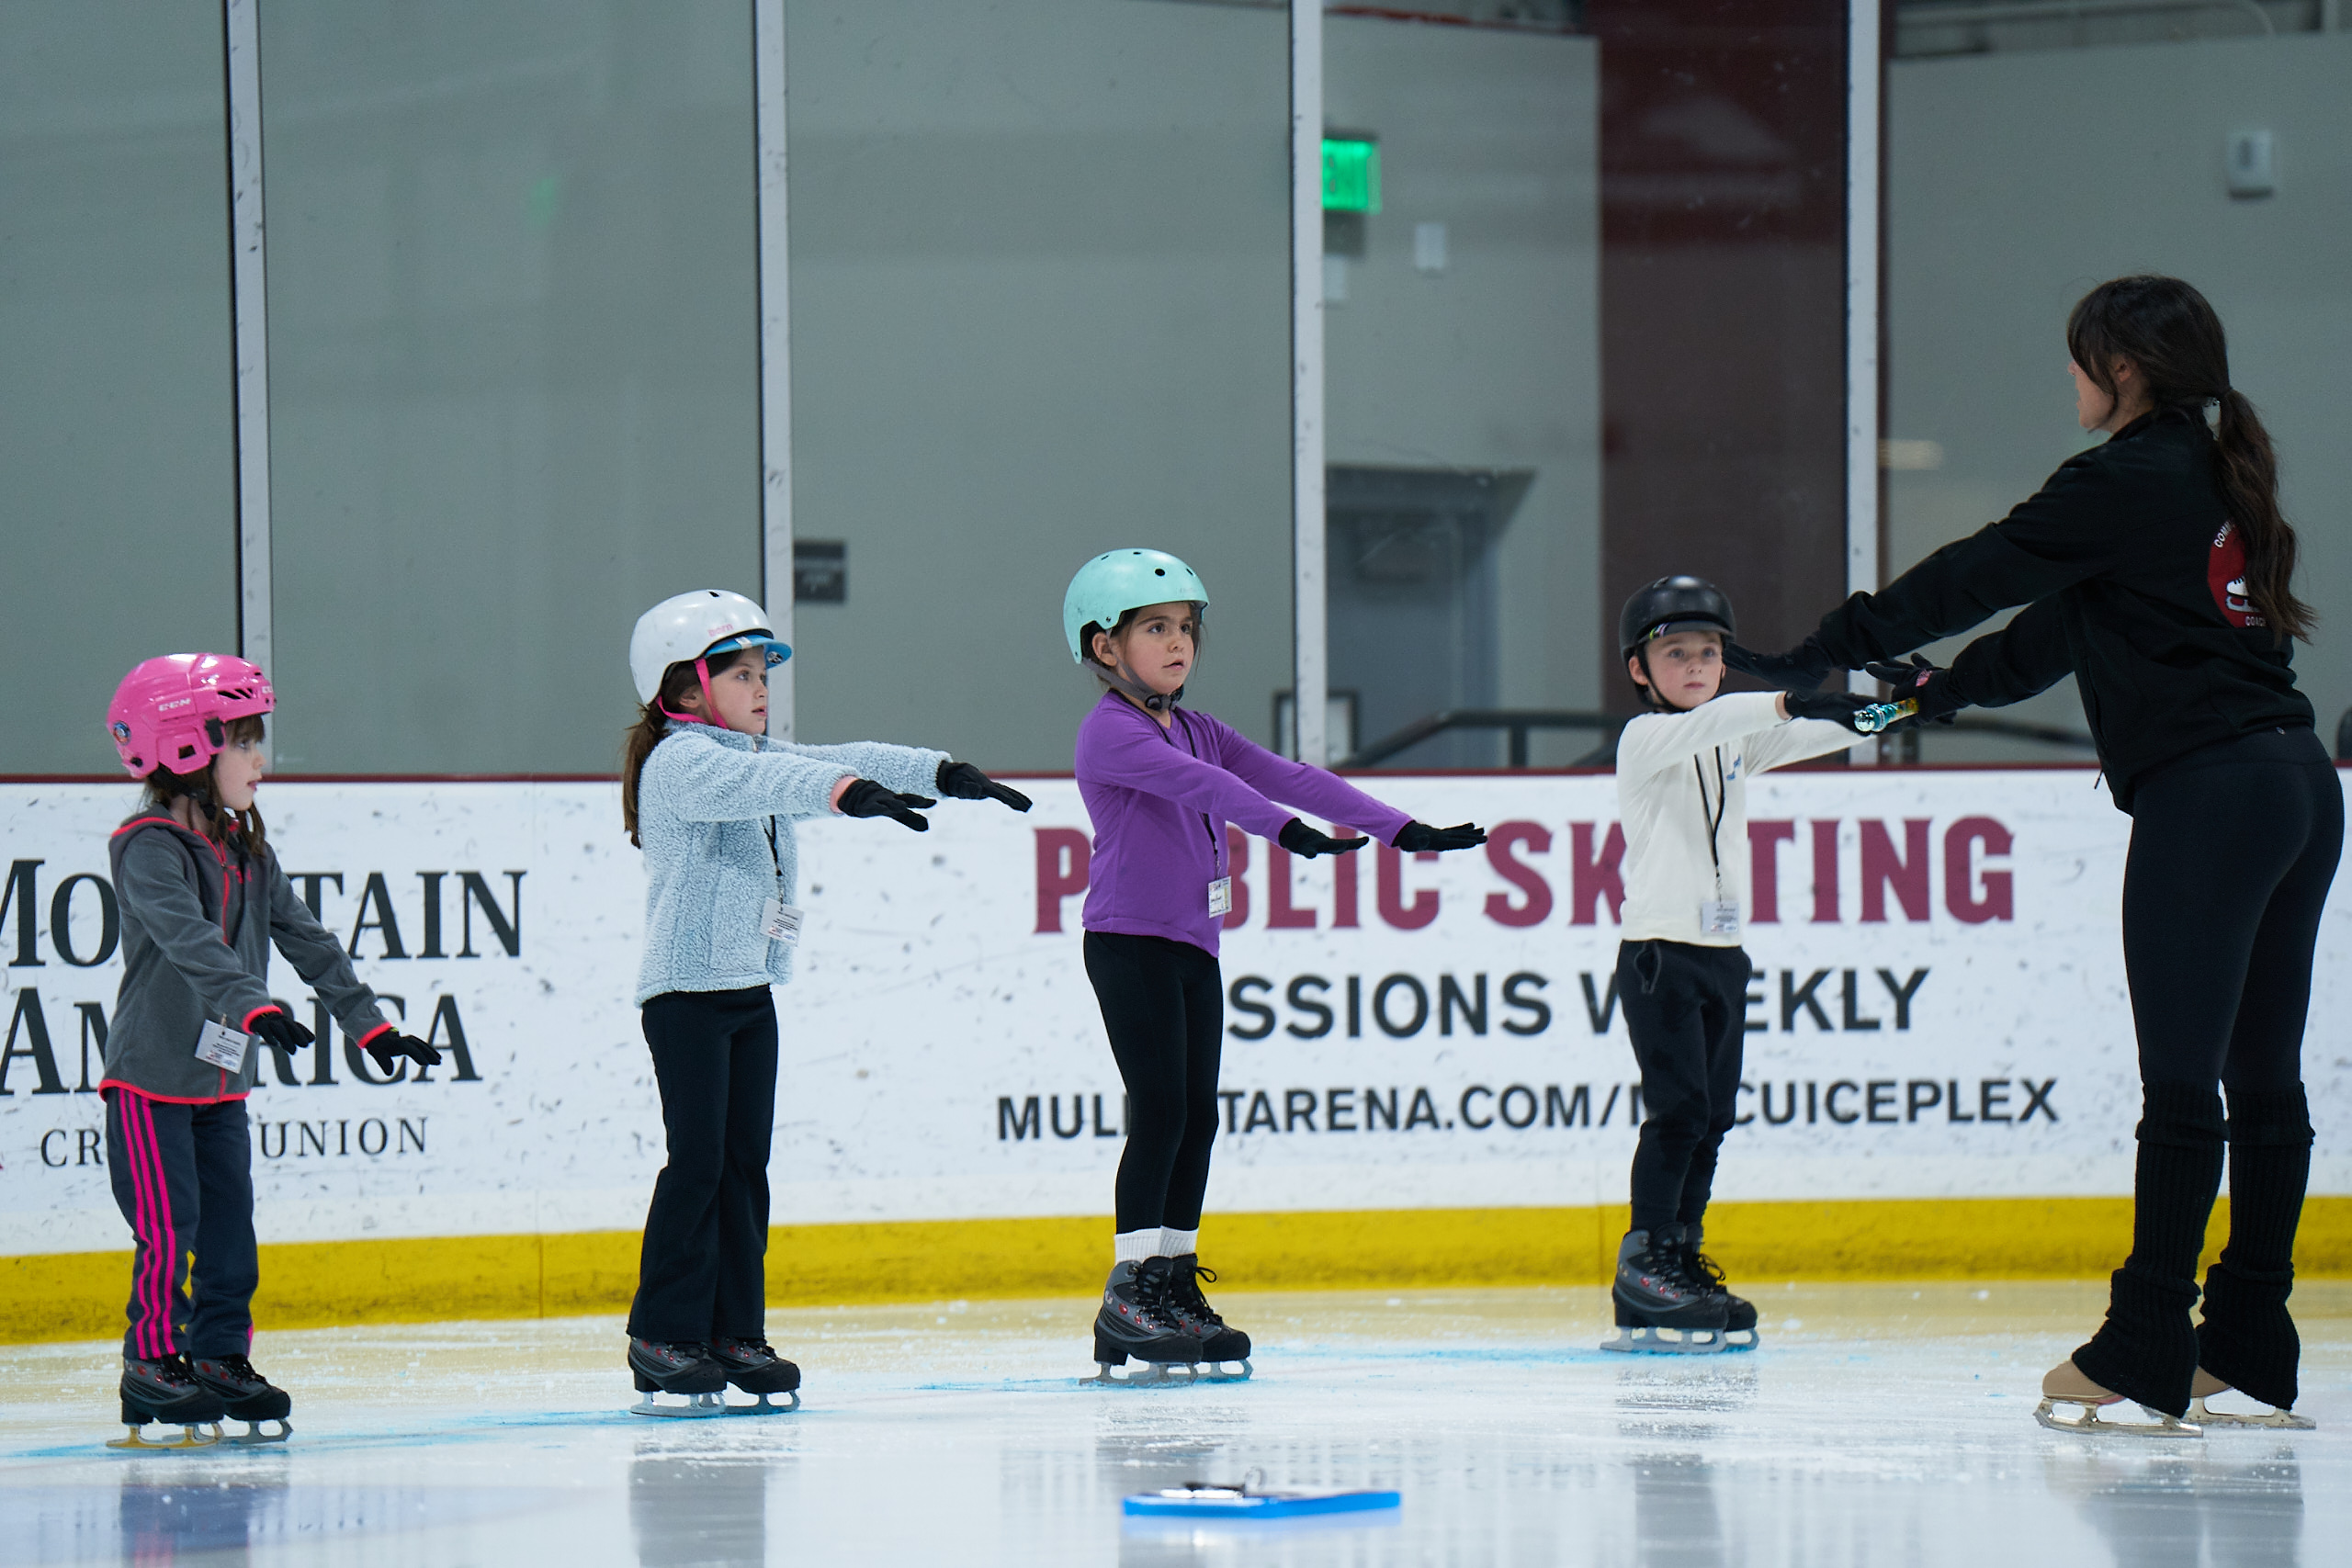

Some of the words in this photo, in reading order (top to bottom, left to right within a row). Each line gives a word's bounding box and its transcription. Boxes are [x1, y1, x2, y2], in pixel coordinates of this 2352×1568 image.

[0, 859, 528, 967] OTAIN
[1034, 824, 1440, 933] PLIC
[1482, 815, 2016, 928] SKTING
[0, 987, 483, 1096] ARICA
[1227, 972, 1552, 1041] SSIONS
[1579, 967, 1931, 1035] EKLY
[259, 1116, 428, 1159] UNION
[997, 1077, 2060, 1141] MULTARENA.COM/UICEPLEX
